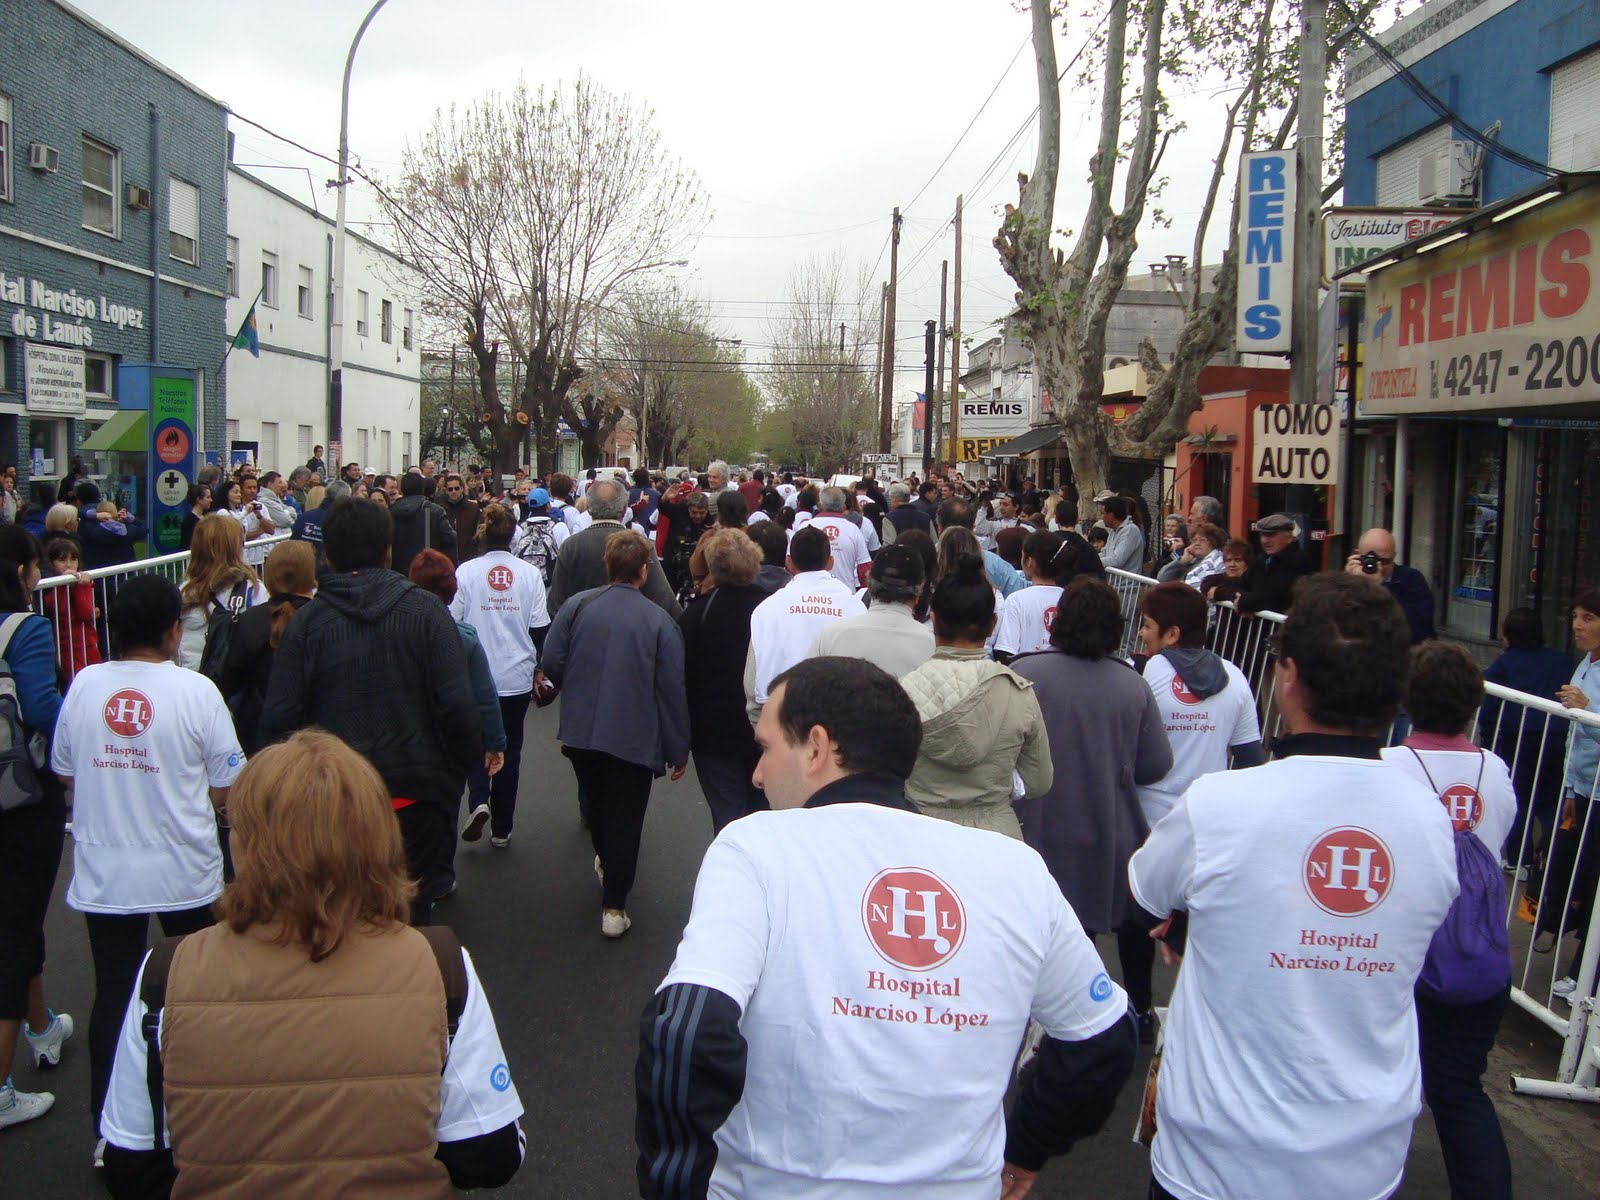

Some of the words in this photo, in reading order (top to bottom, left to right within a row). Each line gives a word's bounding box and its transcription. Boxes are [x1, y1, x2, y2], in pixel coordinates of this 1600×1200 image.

[1331, 219, 1402, 240] Instituto
[1244, 156, 1286, 341] REMIS
[1399, 229, 1591, 347] REMIS
[30, 280, 97, 319] Narciso
[100, 296, 144, 330] Lopez
[12, 308, 37, 337] de
[42, 313, 93, 347] Lanús
[160, 388, 187, 397] Nuestros
[964, 404, 1023, 415] REMIS
[1260, 404, 1332, 436] TOMO
[1258, 447, 1330, 480] AUTO
[488, 597, 513, 605] Hospital
[801, 595, 833, 605] LANÚS
[789, 605, 843, 617] SALUDABLE
[1171, 711, 1209, 722] Hospital
[1164, 724, 1192, 732] arciso
[104, 744, 148, 759] Hospital
[92, 757, 130, 770] Narciso
[131, 759, 161, 775] López
[1299, 929, 1380, 951] Hospital
[1268, 952, 1341, 971] Narciso
[1343, 956, 1396, 977] López
[866, 970, 961, 1000] Hospital
[831, 996, 918, 1024] Narciso
[923, 1006, 989, 1032] López
